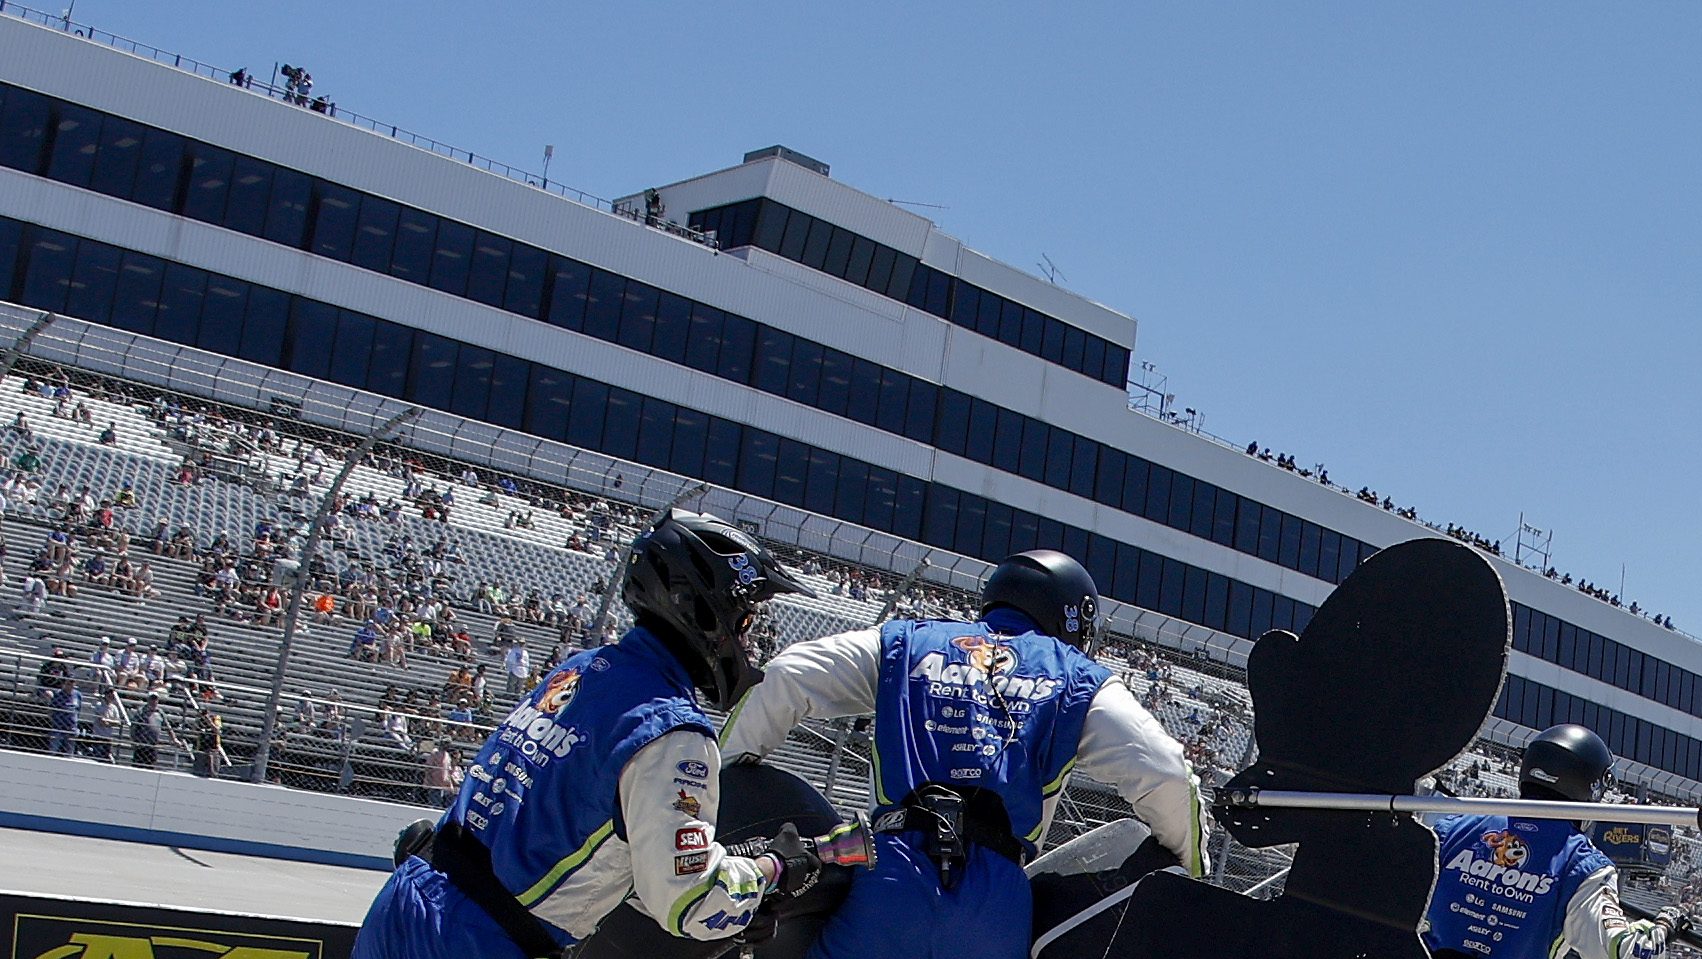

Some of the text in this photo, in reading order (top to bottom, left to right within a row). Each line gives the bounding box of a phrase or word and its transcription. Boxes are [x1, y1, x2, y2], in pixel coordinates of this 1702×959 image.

[728, 553, 757, 585] 38
[1064, 604, 1079, 632] 38
[909, 652, 1058, 701] Aaron's
[929, 682, 969, 698] Rent
[989, 695, 1030, 712] Own
[954, 708, 966, 718] LG
[951, 743, 978, 752] ASHLEY
[680, 832, 705, 846] SEM
[1446, 849, 1555, 894] Aaron's
[1459, 873, 1534, 904] Rent to Own
[1474, 896, 1486, 907] LG
